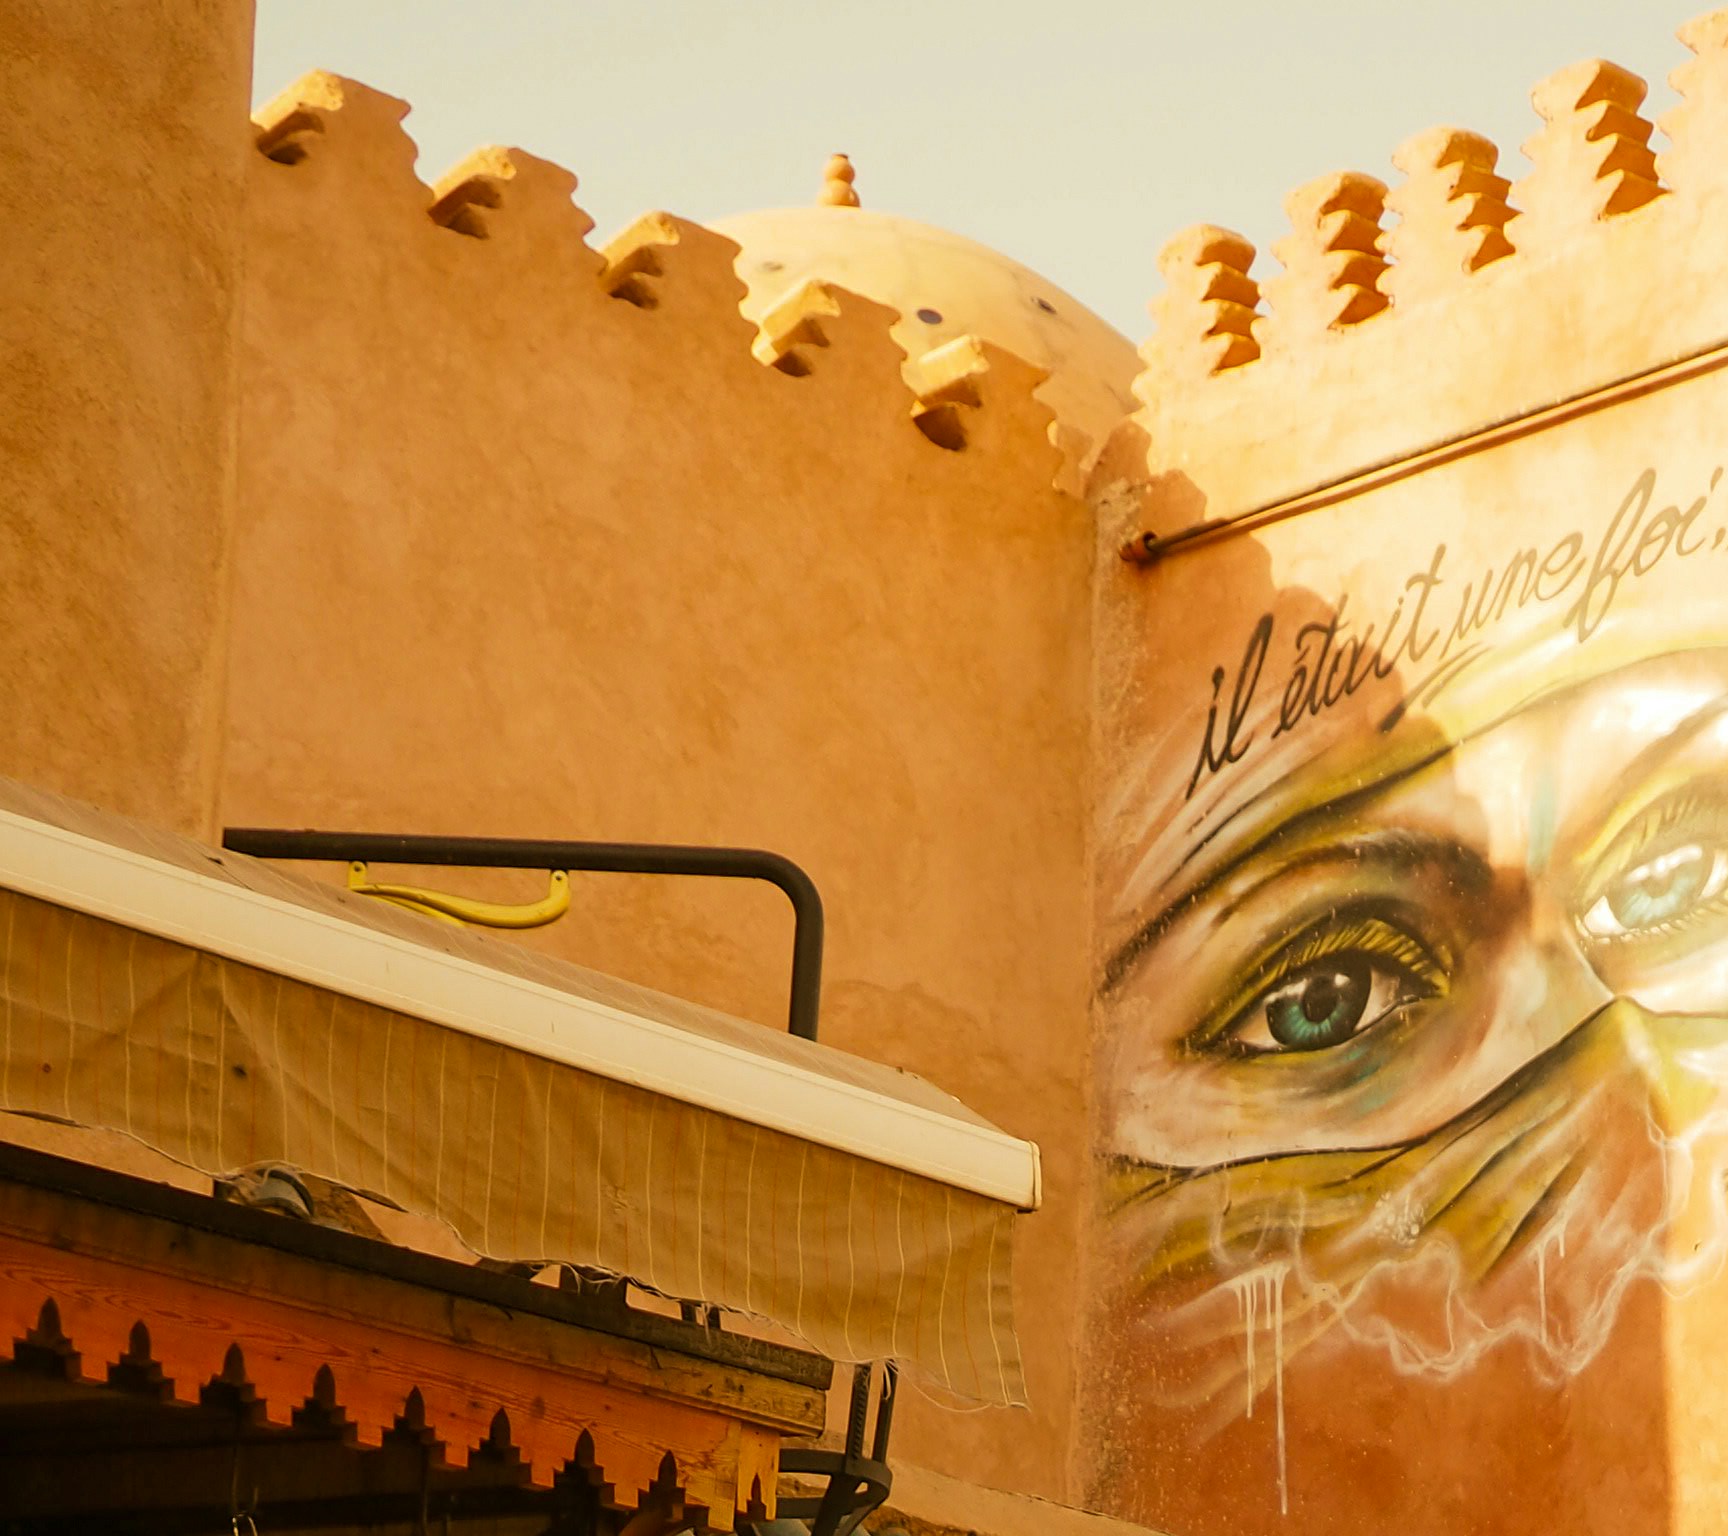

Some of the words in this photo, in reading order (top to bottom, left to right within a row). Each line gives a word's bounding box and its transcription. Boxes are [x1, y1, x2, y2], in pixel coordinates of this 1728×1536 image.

[1185, 612, 1275, 801] il
[1271, 542, 1447, 739] était
[1441, 531, 1587, 658] une
